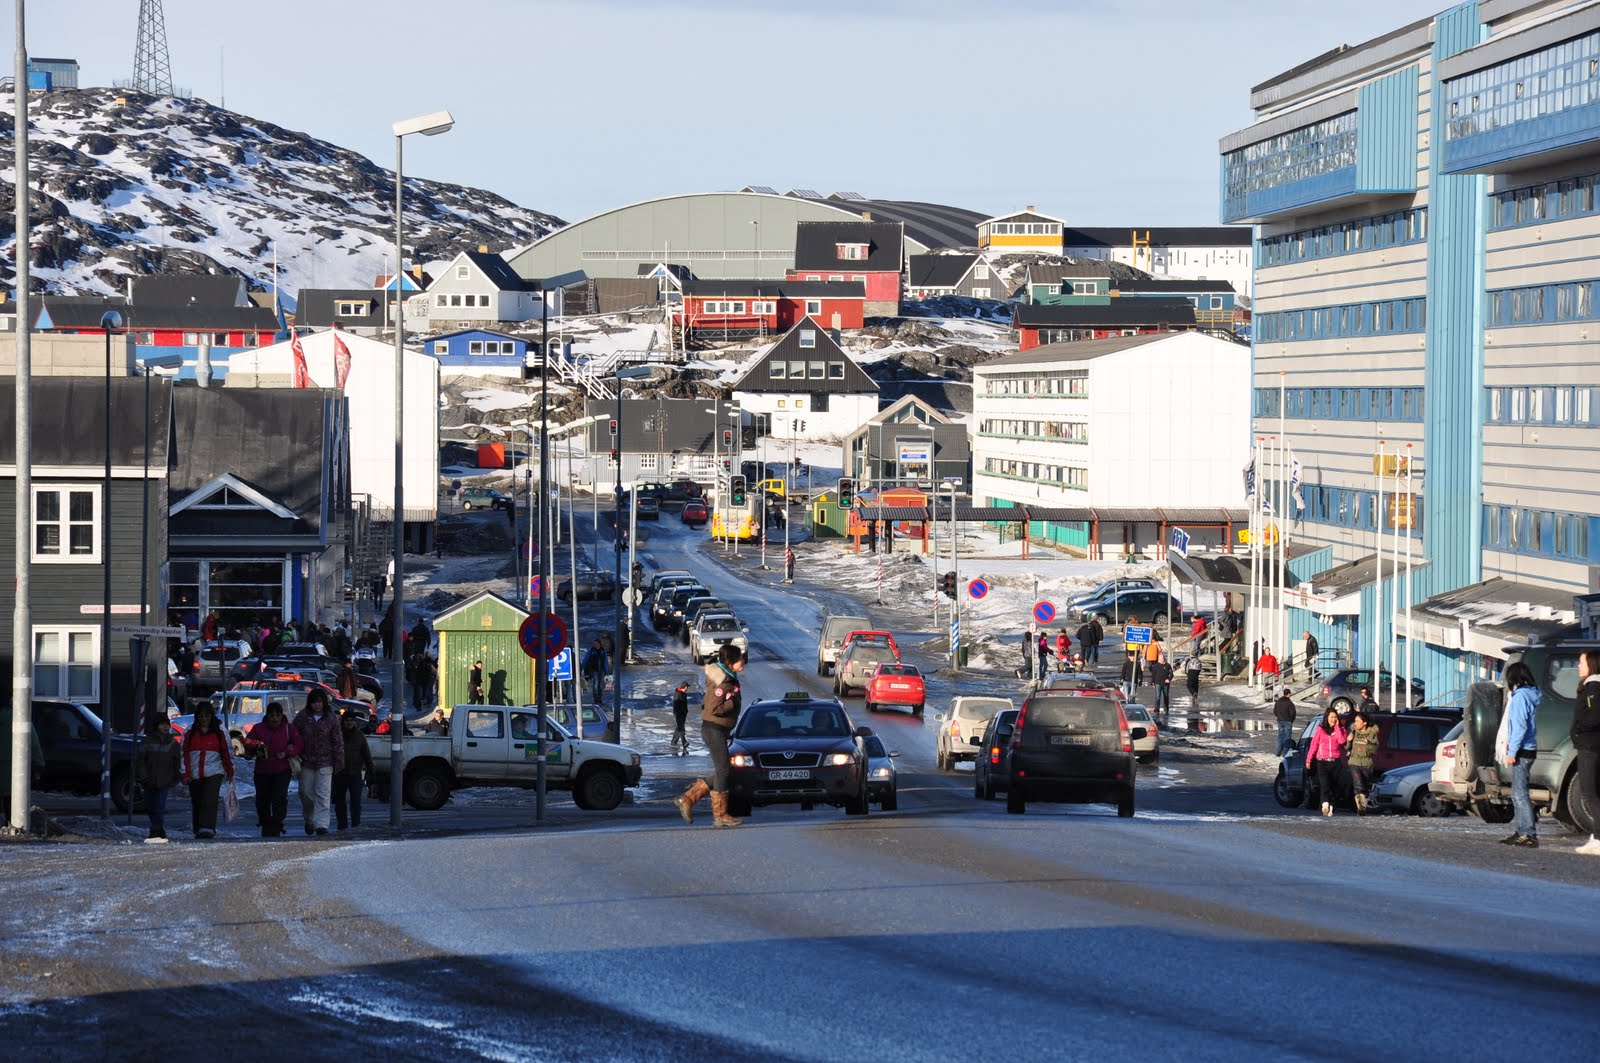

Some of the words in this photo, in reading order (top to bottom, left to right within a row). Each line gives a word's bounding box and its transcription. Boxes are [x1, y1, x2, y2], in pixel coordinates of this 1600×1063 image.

[1052, 736, 1063, 744] GR
[770, 771, 781, 779] GR
[794, 770, 809, 778] 420
